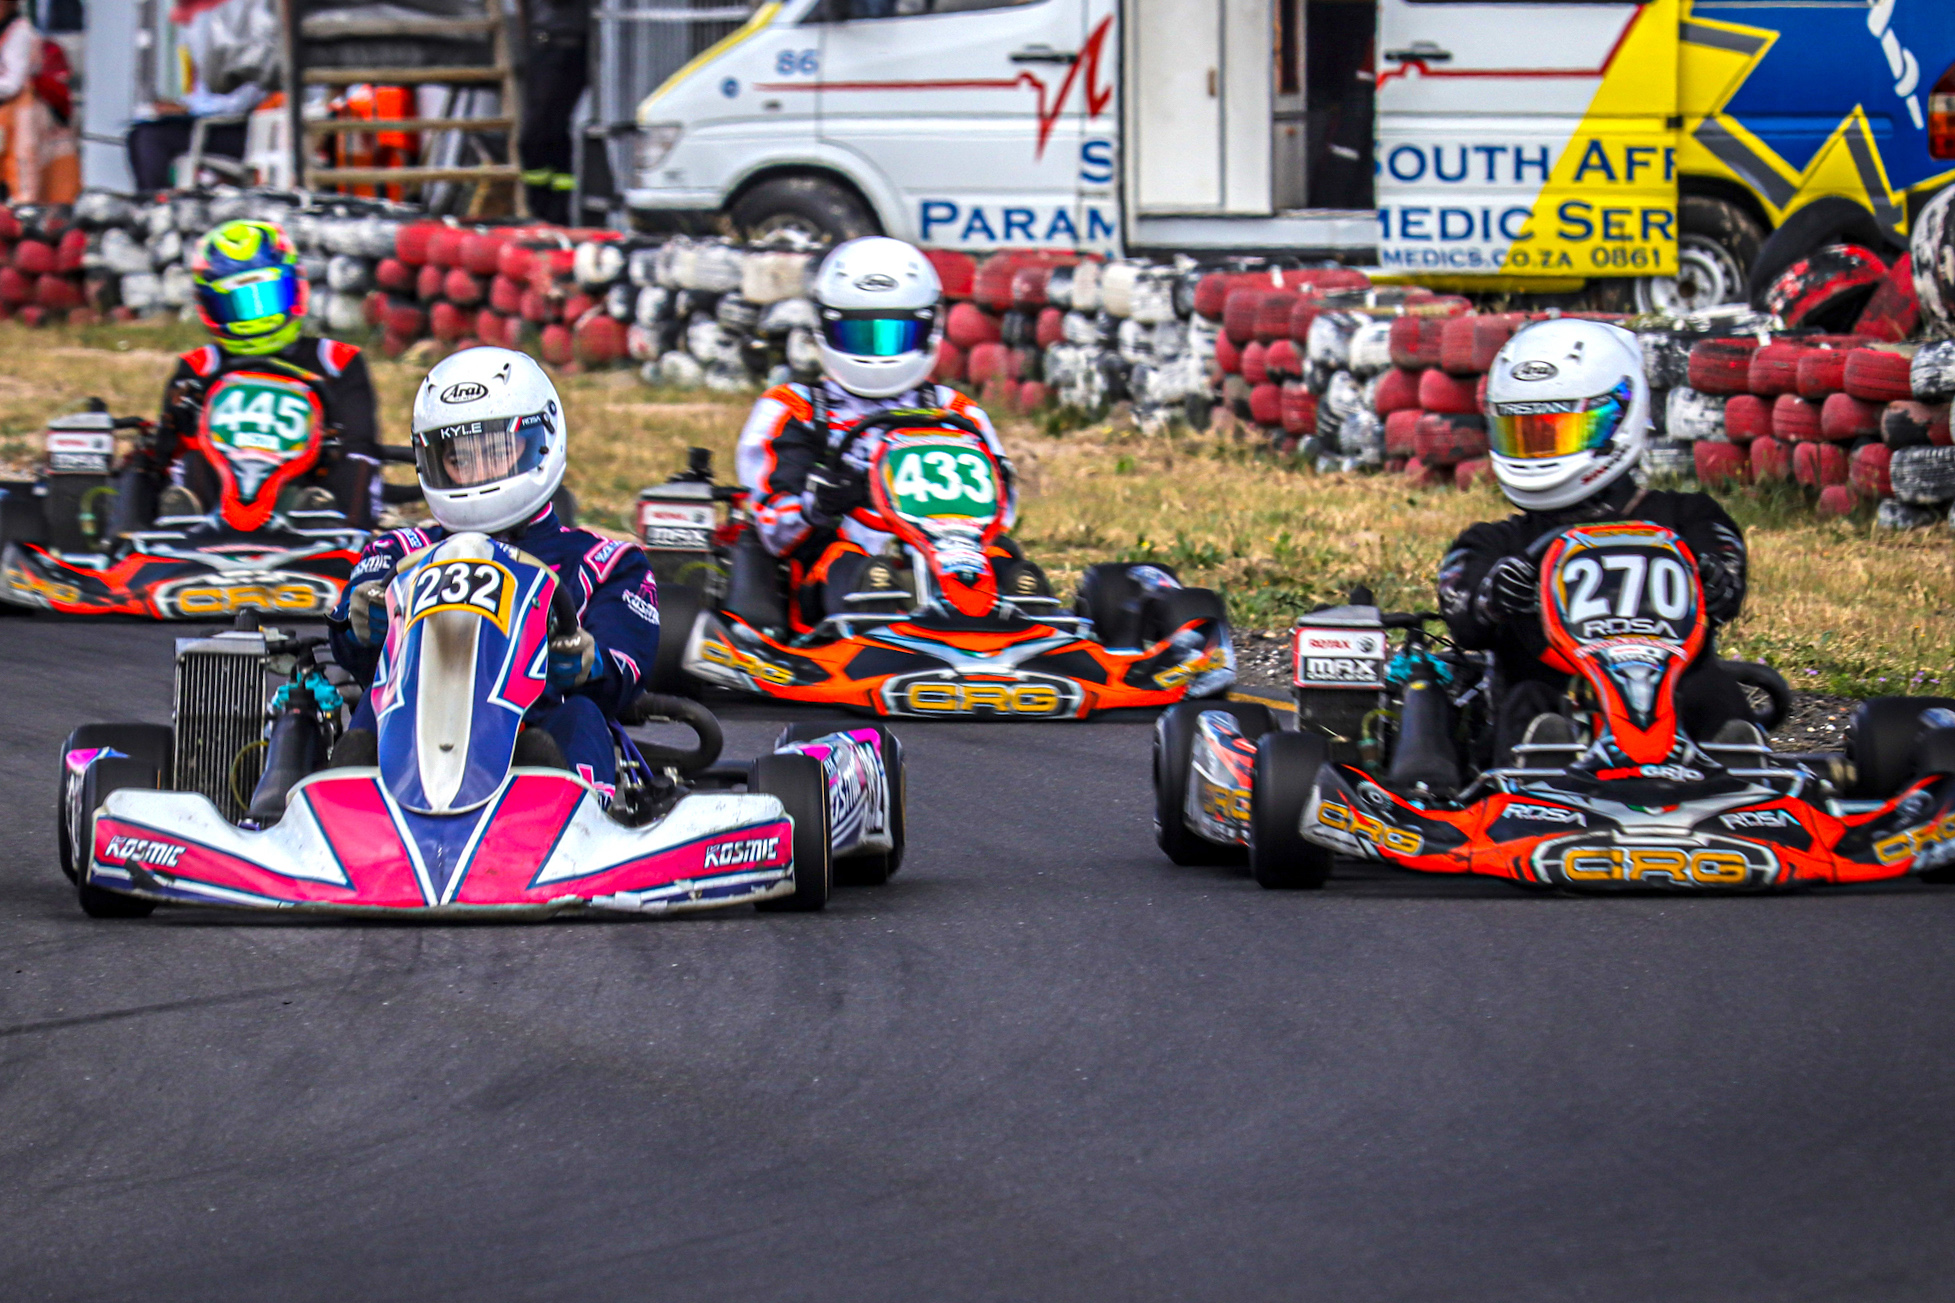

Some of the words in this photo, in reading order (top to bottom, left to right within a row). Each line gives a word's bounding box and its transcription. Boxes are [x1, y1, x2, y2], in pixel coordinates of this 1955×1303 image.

[1374, 142, 1549, 182] OUTH
[1591, 247, 1661, 268] 0861
[209, 389, 312, 441] 445
[440, 422, 482, 440] KYLE
[894, 452, 996, 504] 433
[179, 584, 318, 614] CRG
[413, 562, 501, 616] 232
[1562, 553, 1691, 625] 270
[1583, 618, 1679, 639] ROSA
[907, 682, 1060, 713] CRG
[1317, 800, 1424, 857] CRG
[1503, 803, 1587, 828] ROSA
[1719, 809, 1800, 830] ROSA
[104, 835, 187, 868] KOSMIC
[703, 836, 780, 869] KOSMIC
[1563, 847, 1749, 887] CRG
